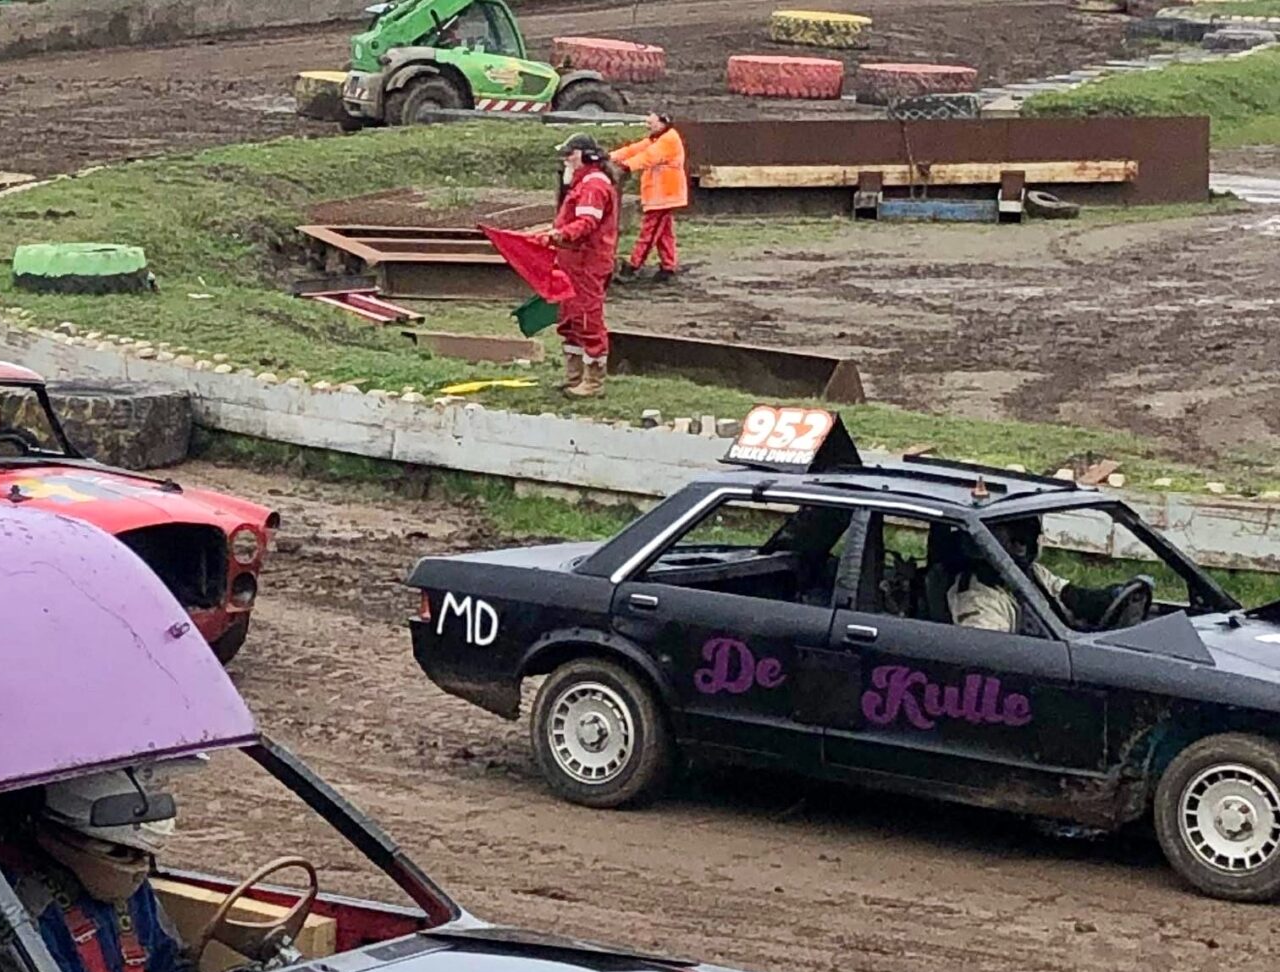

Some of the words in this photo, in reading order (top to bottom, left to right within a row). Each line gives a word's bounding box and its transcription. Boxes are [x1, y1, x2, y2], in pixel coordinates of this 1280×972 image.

[738, 405, 833, 451] 952
[435, 591, 499, 646] MD
[693, 636, 786, 695] De
[860, 663, 1033, 730] Kulle
